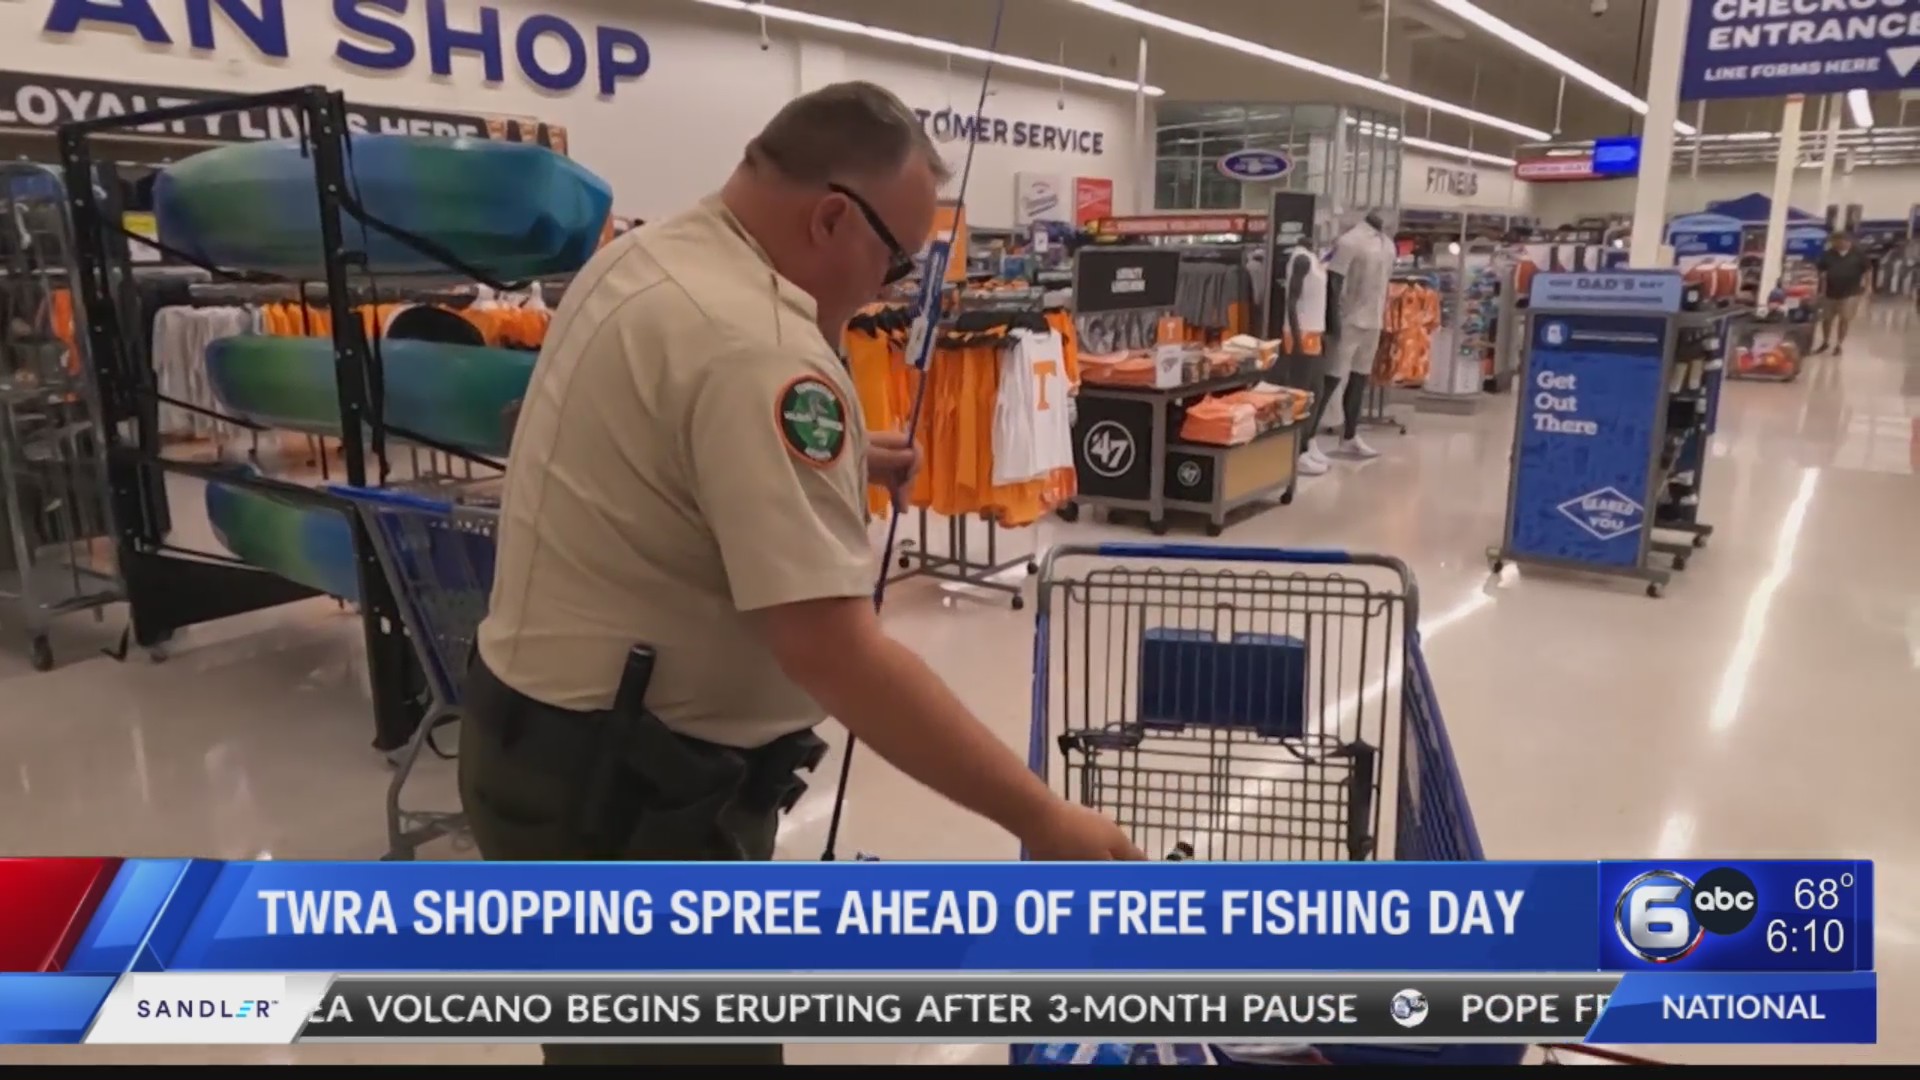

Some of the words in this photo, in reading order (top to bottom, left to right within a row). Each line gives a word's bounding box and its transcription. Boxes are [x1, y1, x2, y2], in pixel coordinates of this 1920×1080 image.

[1707, 11, 1920, 50] ENTRANCE
[332, 0, 650, 96] SHOP
[1704, 66, 1748, 81] LINE
[1750, 61, 1821, 78] FORMS
[1823, 57, 1881, 74] HERE
[239, 106, 368, 139] LIVS
[1013, 121, 1104, 154] SERVICE
[1033, 360, 1057, 411] T
[1536, 370, 1577, 390] Get
[1534, 392, 1578, 412] Out
[1532, 412, 1598, 436] There
